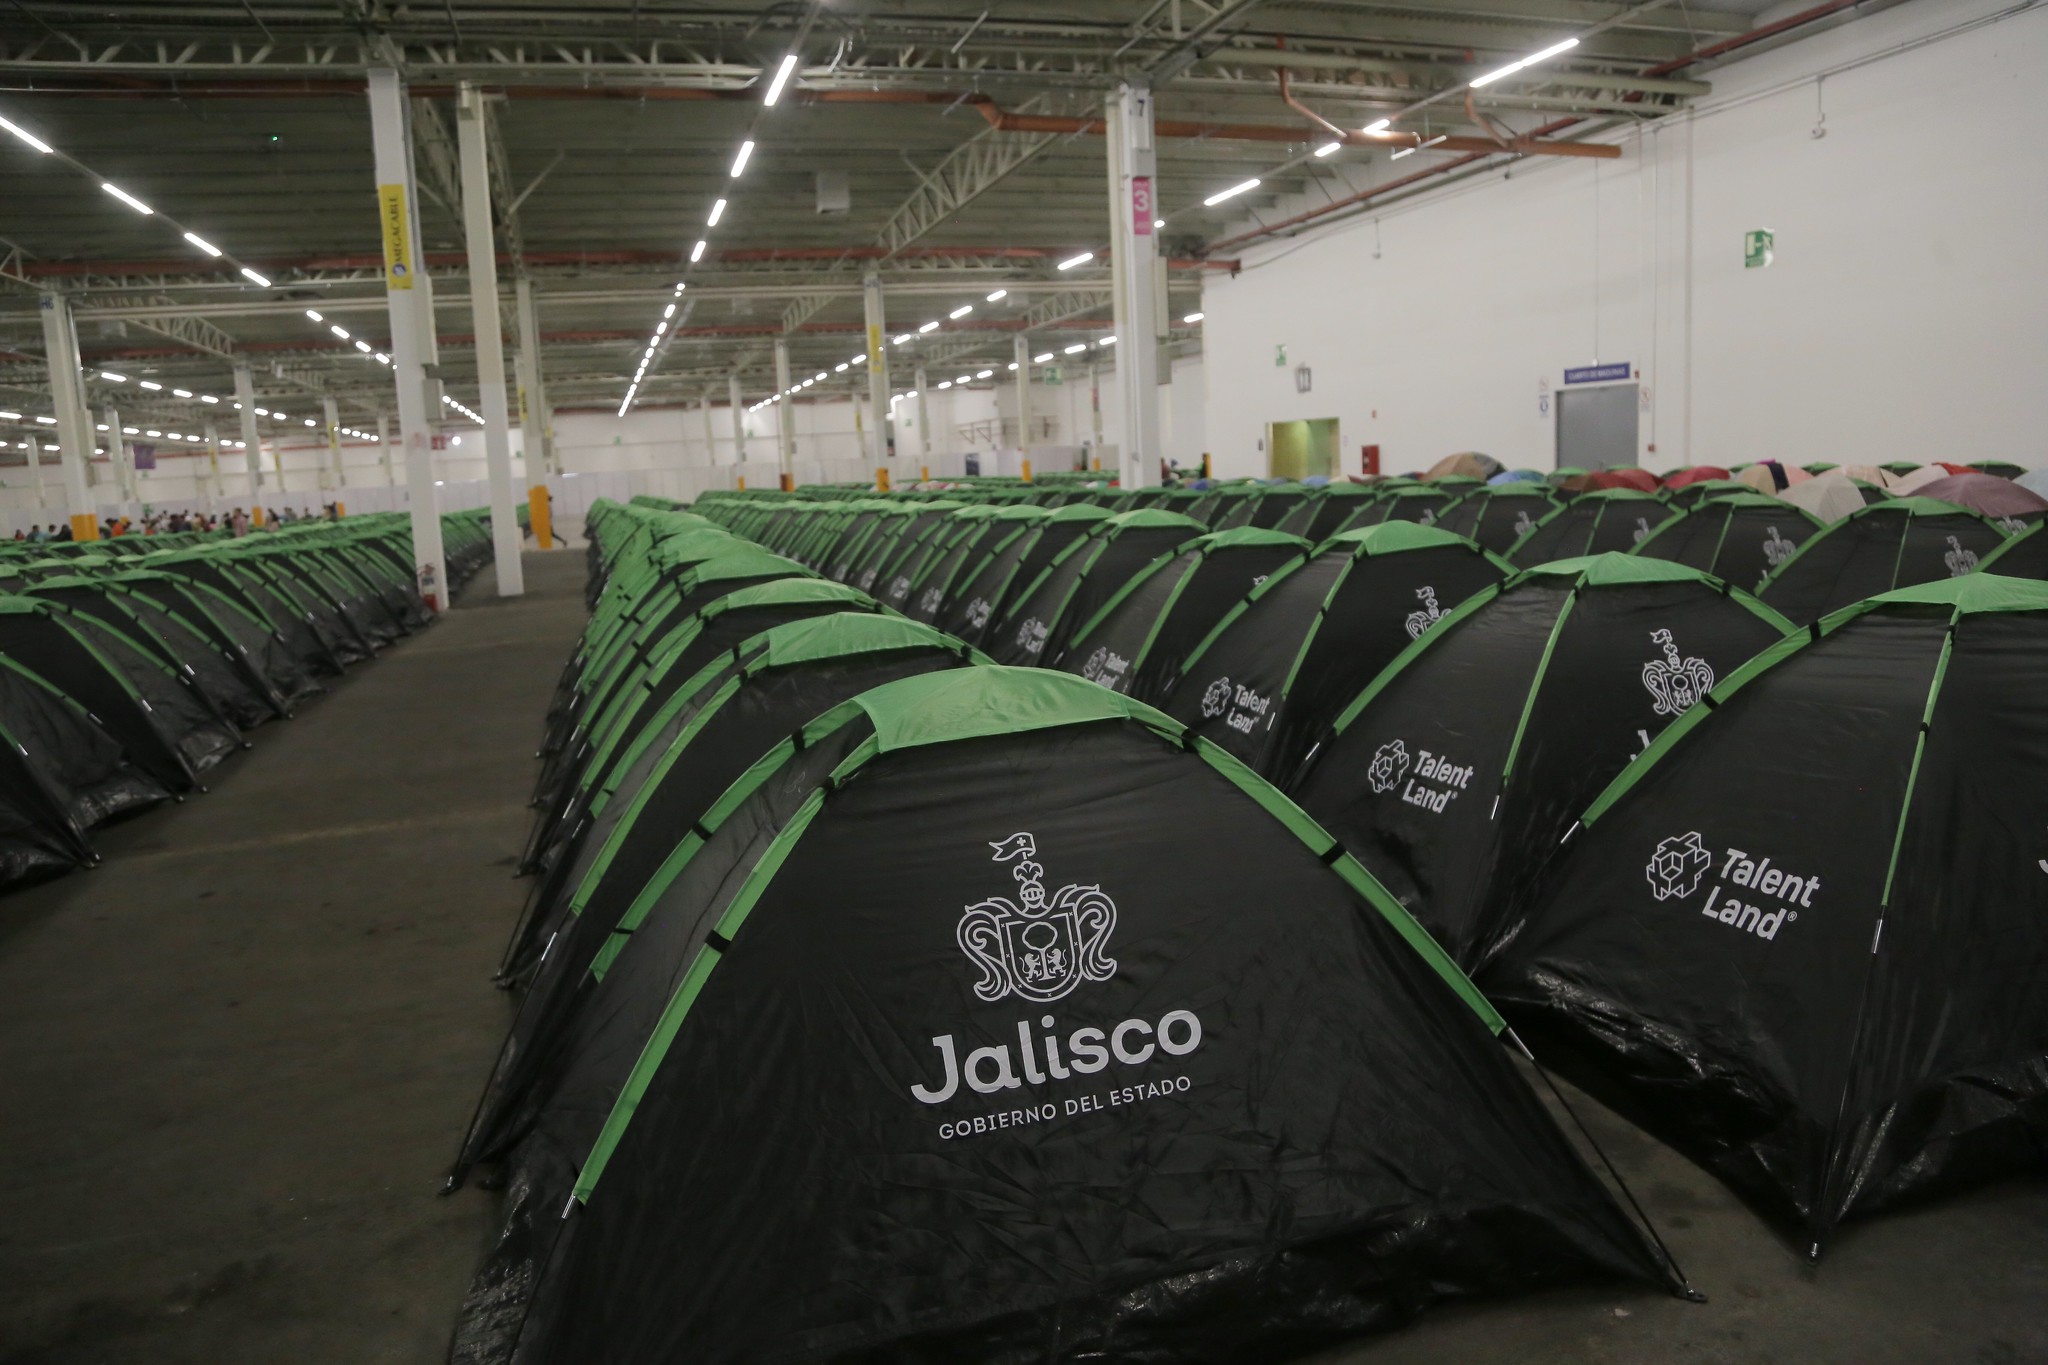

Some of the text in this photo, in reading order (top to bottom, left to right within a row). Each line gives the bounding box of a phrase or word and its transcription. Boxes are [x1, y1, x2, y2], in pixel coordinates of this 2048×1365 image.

[1134, 189, 1150, 212] 3
[1234, 683, 1271, 715] Talent
[1413, 749, 1474, 790] Talent
[1719, 847, 1821, 908] Talent
[910, 1009, 1202, 1104] Jalisco
[938, 1075, 1191, 1140] GOBIERNO DEL ESTADO
